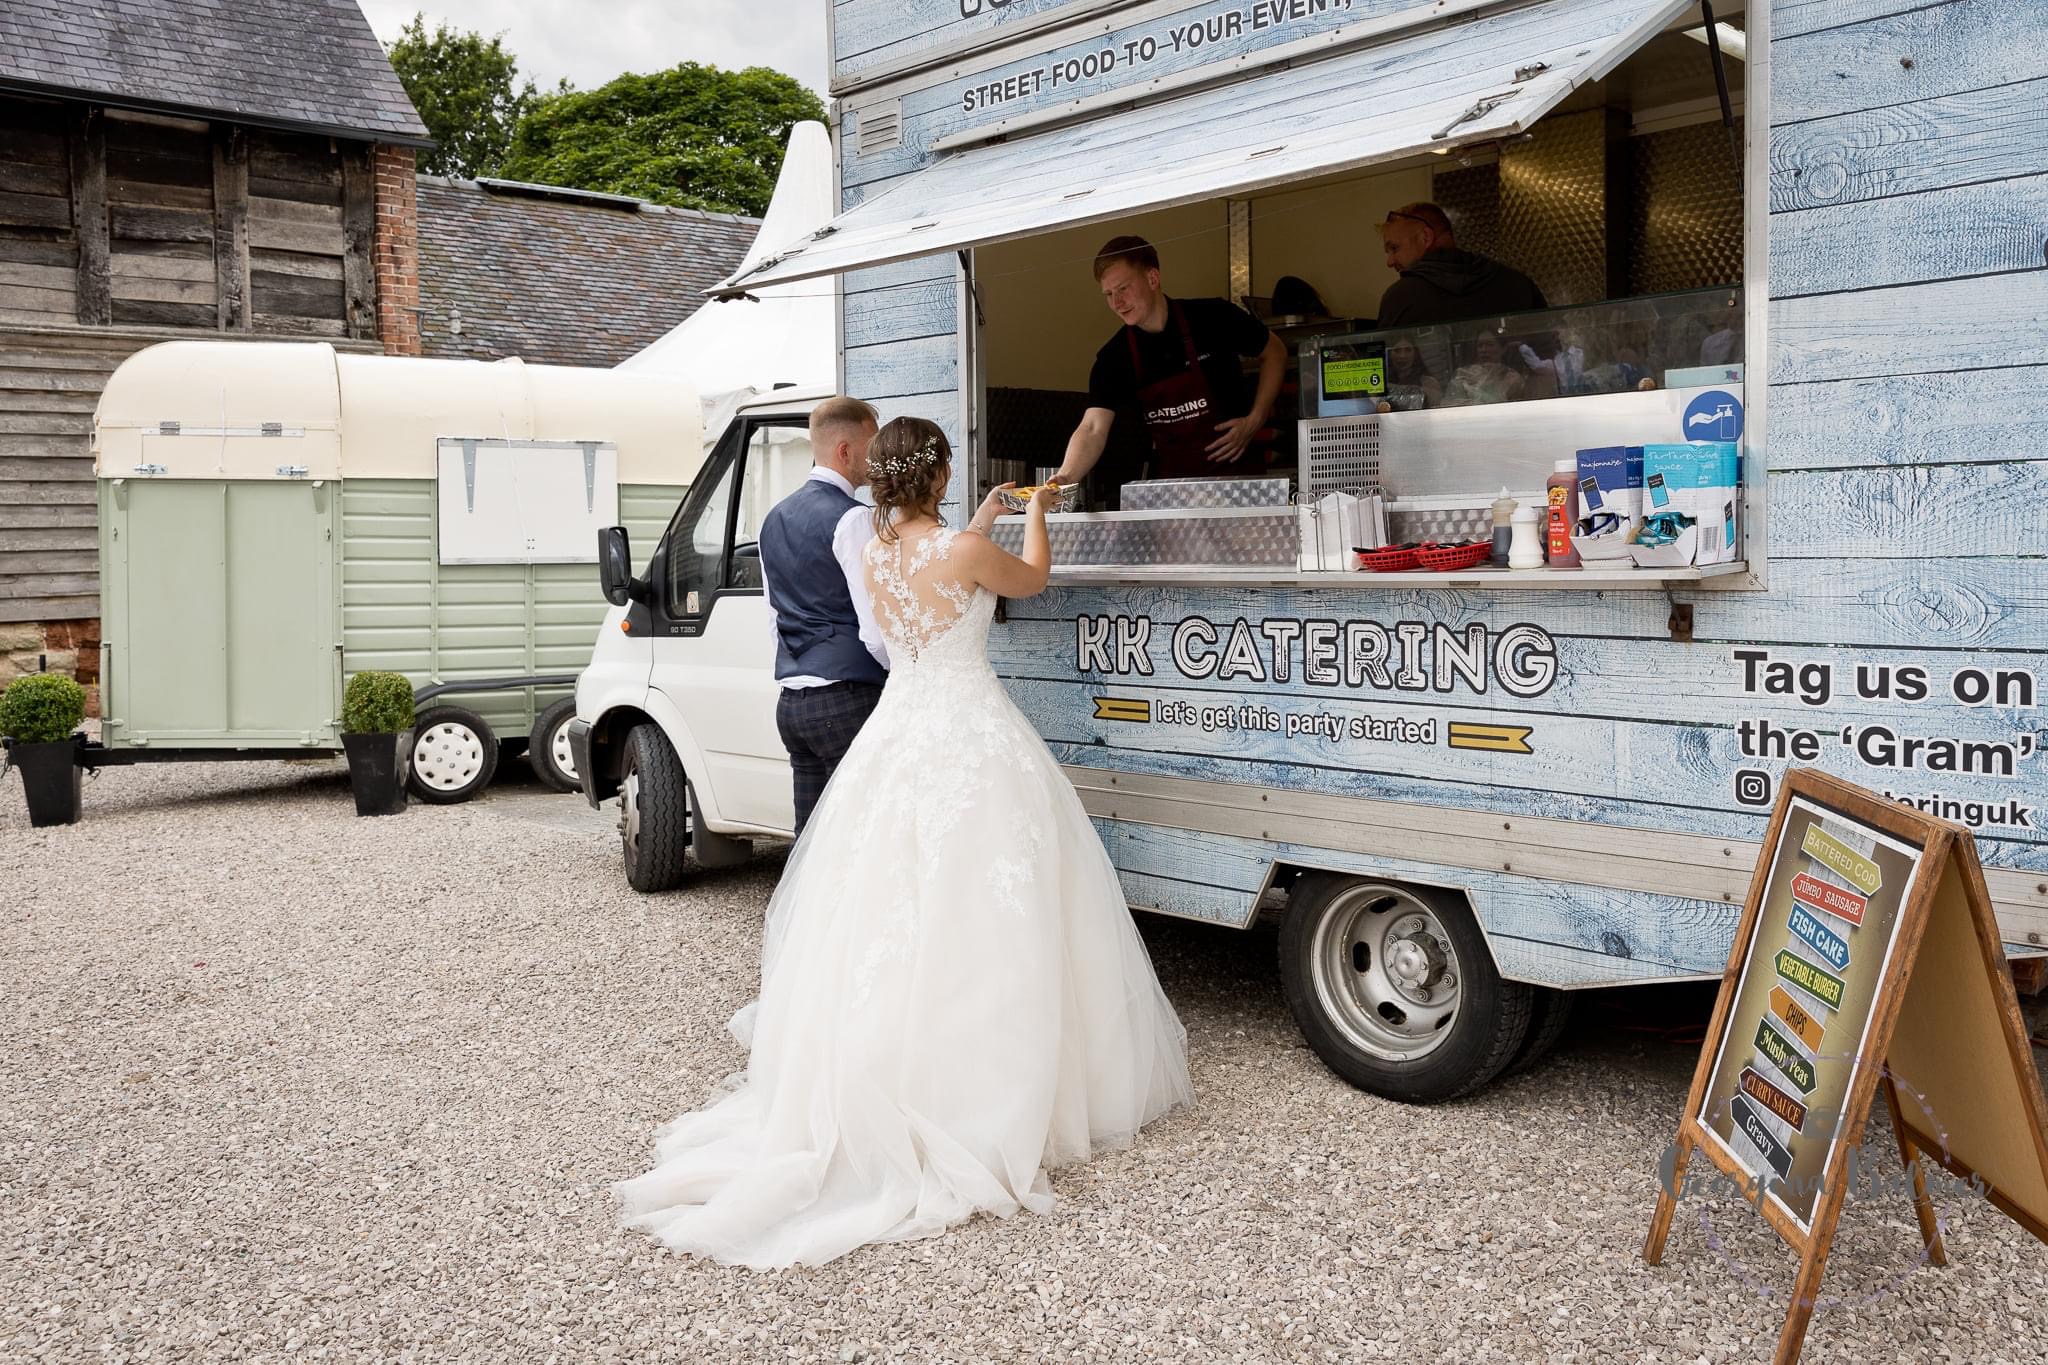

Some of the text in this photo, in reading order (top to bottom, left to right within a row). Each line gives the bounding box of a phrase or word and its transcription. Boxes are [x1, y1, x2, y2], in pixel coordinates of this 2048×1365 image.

[962, 0, 1351, 112] STREET FOOD TO YOUR EVEN,
[1148, 398, 1207, 418] CATERING
[1076, 614, 1558, 697] KK CATERING
[1734, 650, 2033, 706] Tag us on
[1156, 700, 1436, 744] let's get this party started
[1737, 720, 2032, 776] the 'Gram'
[1807, 831, 1876, 887] BATTERED COD
[1797, 880, 1861, 915] JUMBO SAUSAGE
[1791, 912, 1845, 964] FISH CAKE
[1778, 953, 1840, 1004] VEGETABLE BURGER
[1785, 1003, 1808, 1036] CHIPS
[1760, 1029, 1809, 1088] Mushy Peas
[1746, 1074, 1801, 1126] CURRY SAUCE
[1746, 1115, 1775, 1158] Gravy
